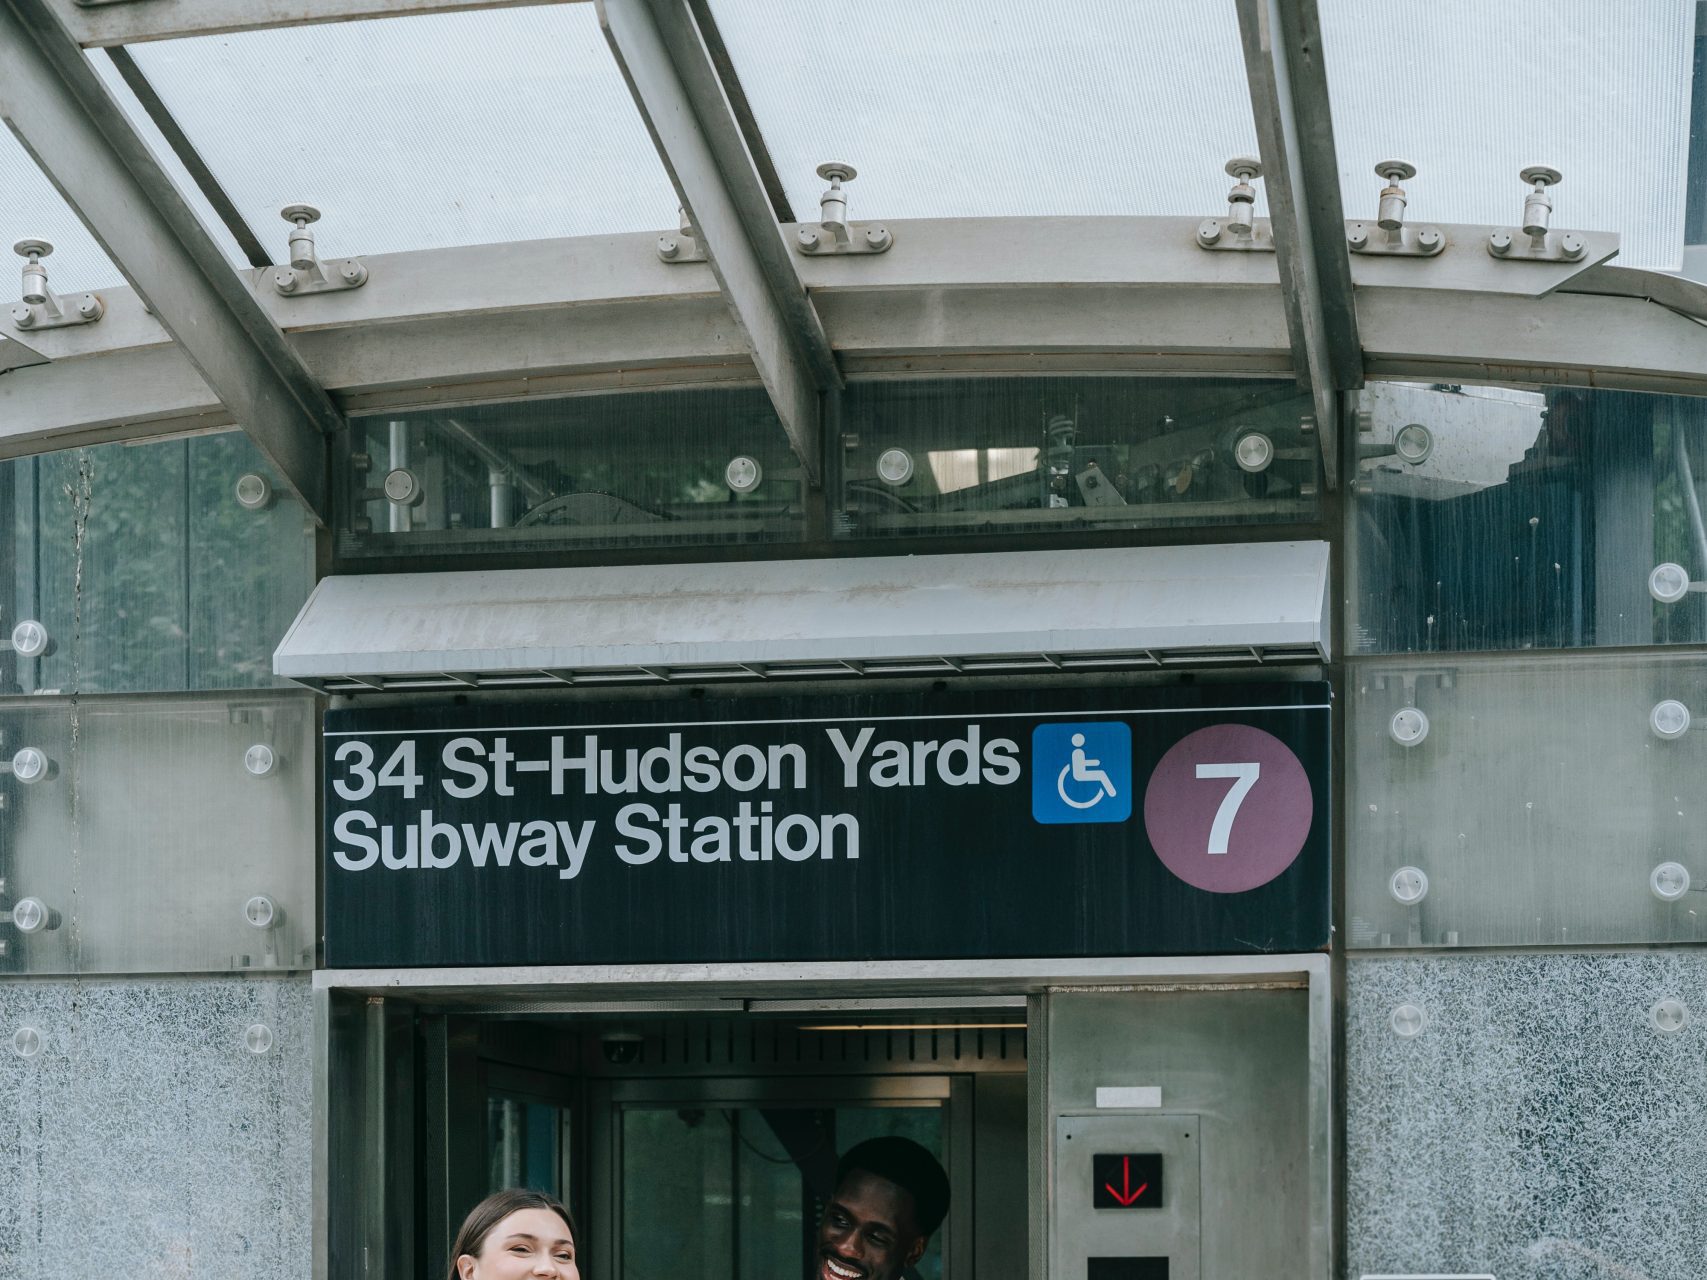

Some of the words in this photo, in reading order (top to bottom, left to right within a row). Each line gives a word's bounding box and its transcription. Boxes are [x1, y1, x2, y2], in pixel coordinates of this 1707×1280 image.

[332, 741, 423, 802] 34
[826, 725, 1021, 790] Yards
[332, 810, 595, 879] Subway
[614, 802, 861, 865] Station
[1194, 761, 1261, 855] 7
